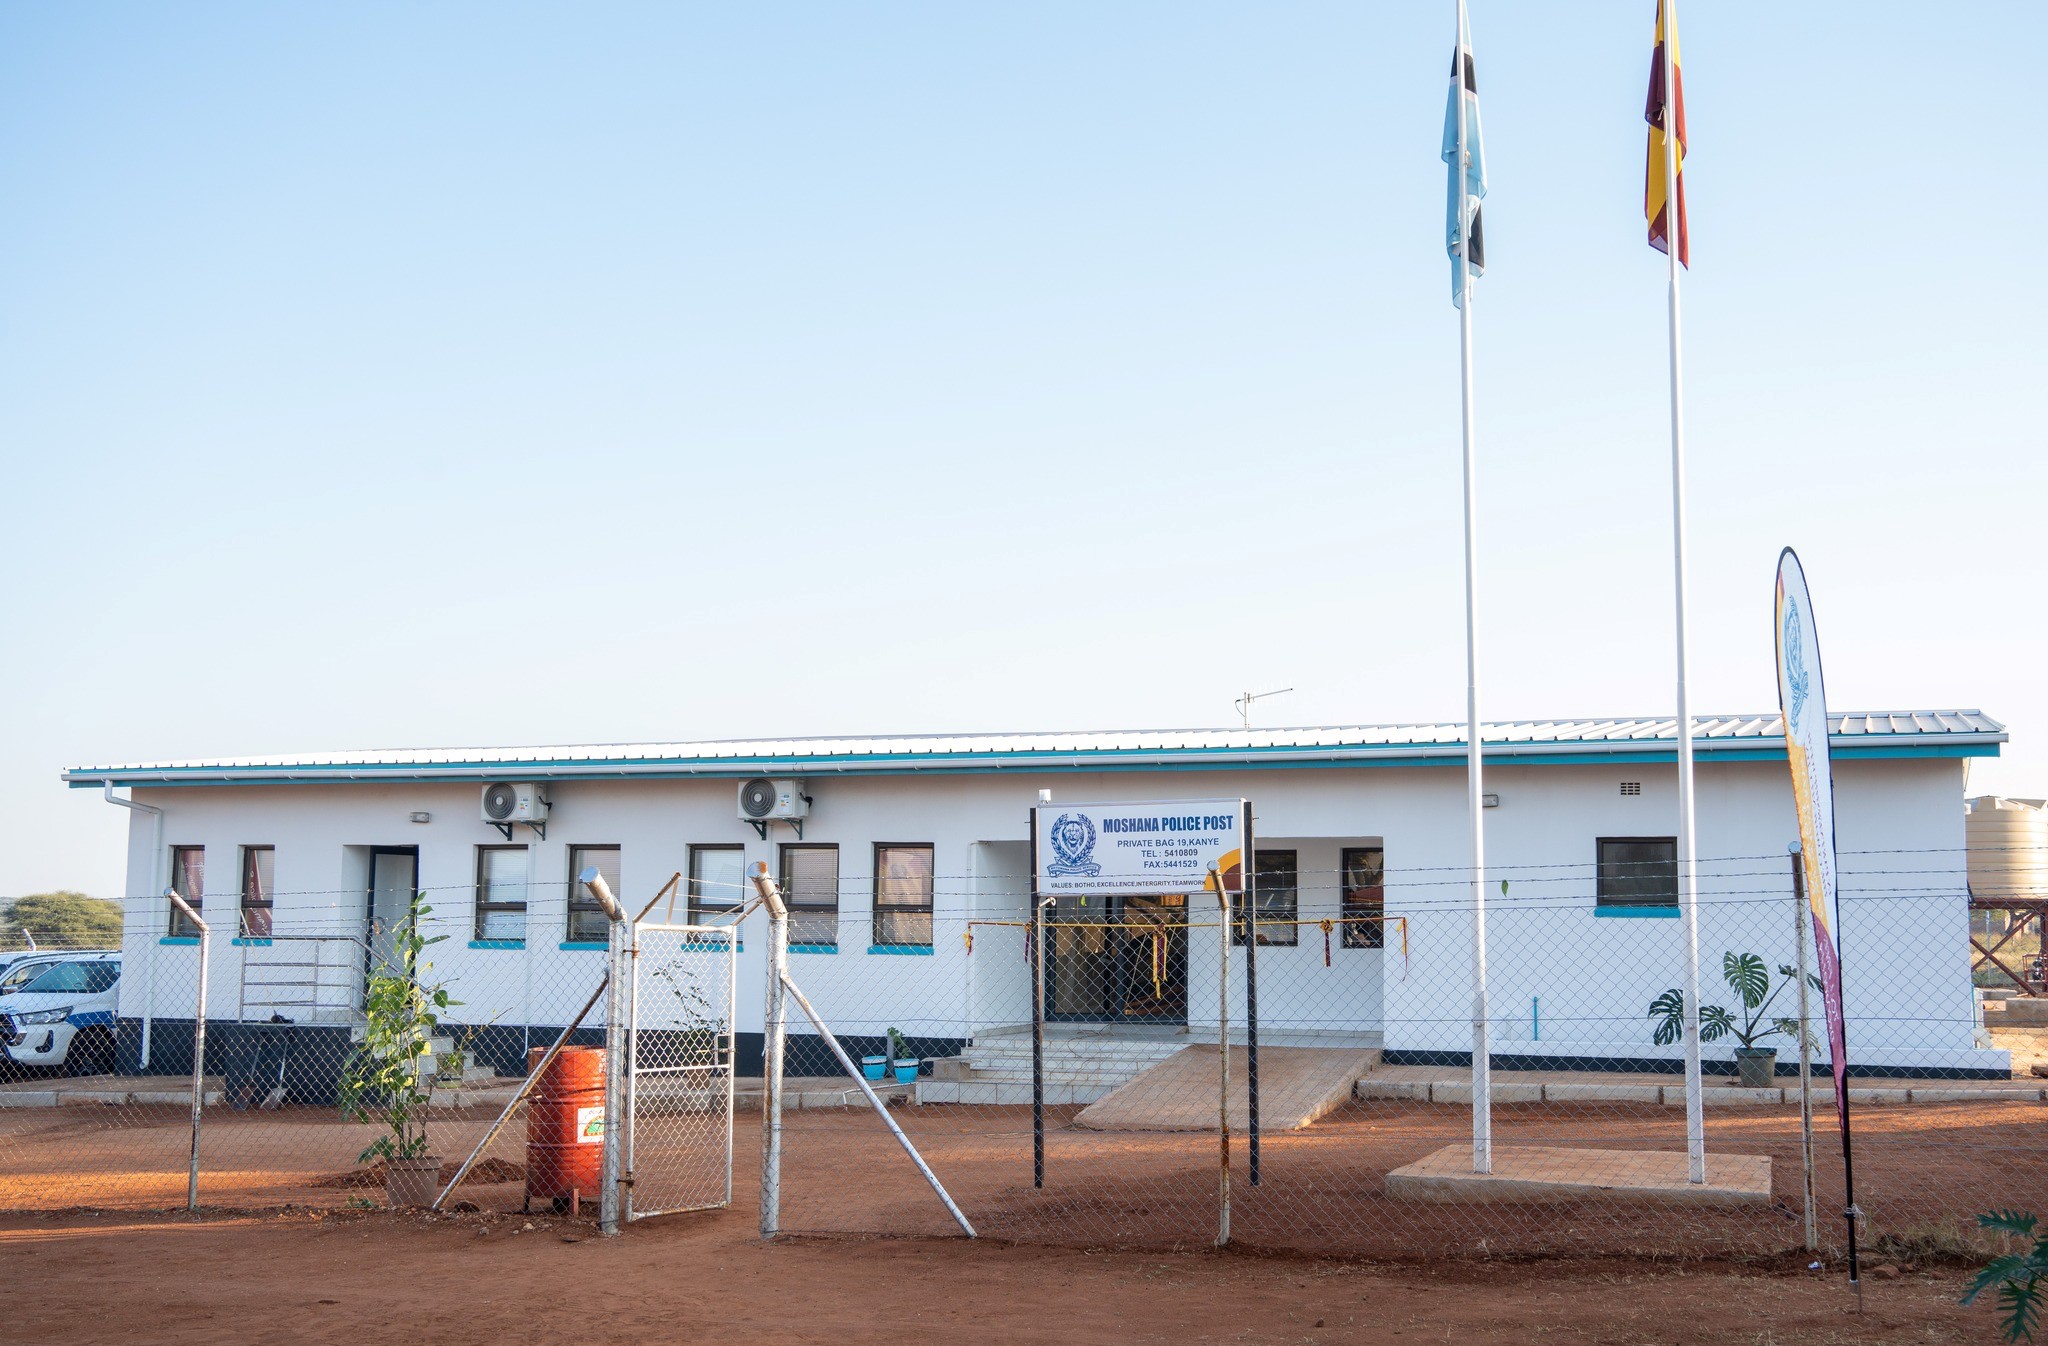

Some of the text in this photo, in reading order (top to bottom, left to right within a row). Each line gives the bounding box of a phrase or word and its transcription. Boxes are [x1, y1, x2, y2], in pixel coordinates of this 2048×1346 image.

[1103, 815, 1234, 833] MOSHANA POLICE POST
[1117, 839, 1153, 848] PRIVATE
[1155, 839, 1174, 847] BAG
[1164, 848, 1198, 857] 5410809
